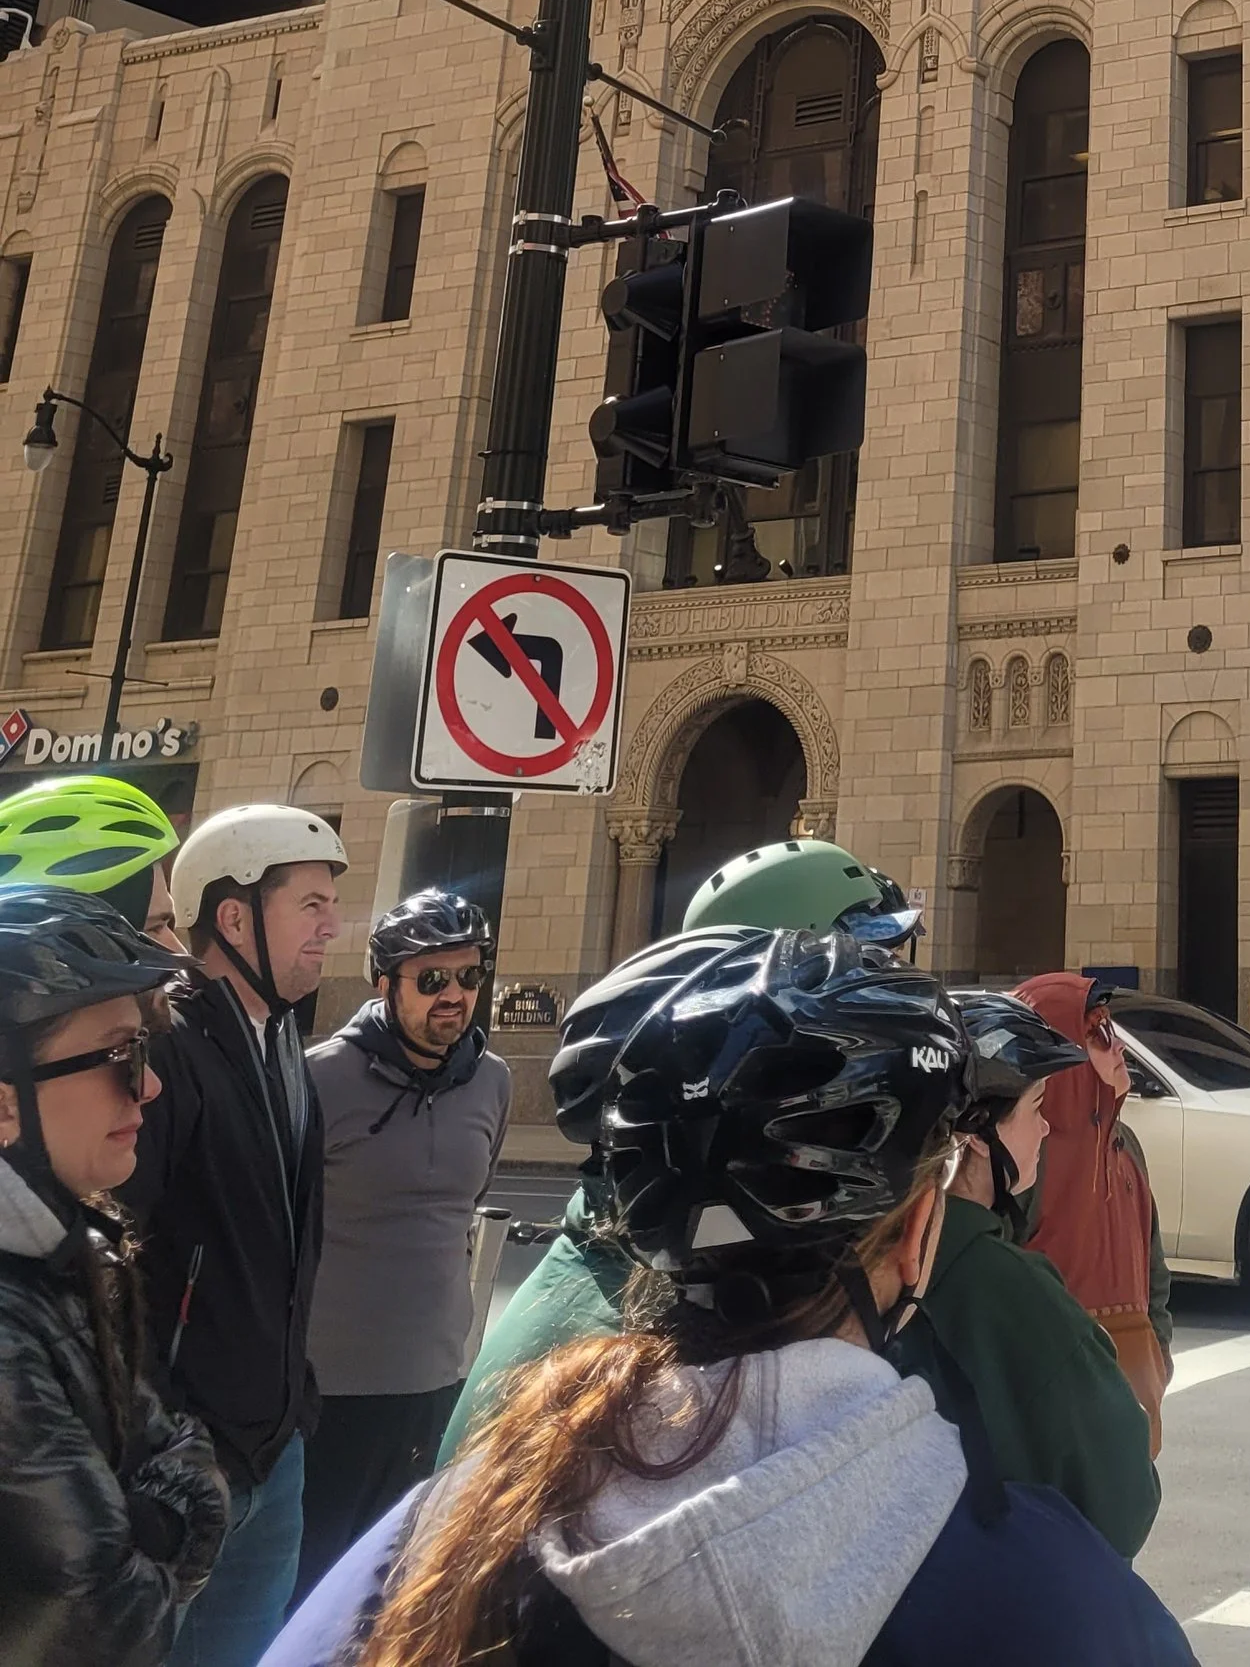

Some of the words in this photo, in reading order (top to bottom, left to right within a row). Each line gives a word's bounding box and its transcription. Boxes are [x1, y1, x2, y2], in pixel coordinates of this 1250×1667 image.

[25, 717, 182, 765] Domno's
[503, 1011, 552, 1023] BUILDING
[912, 1046, 950, 1073] KALI
